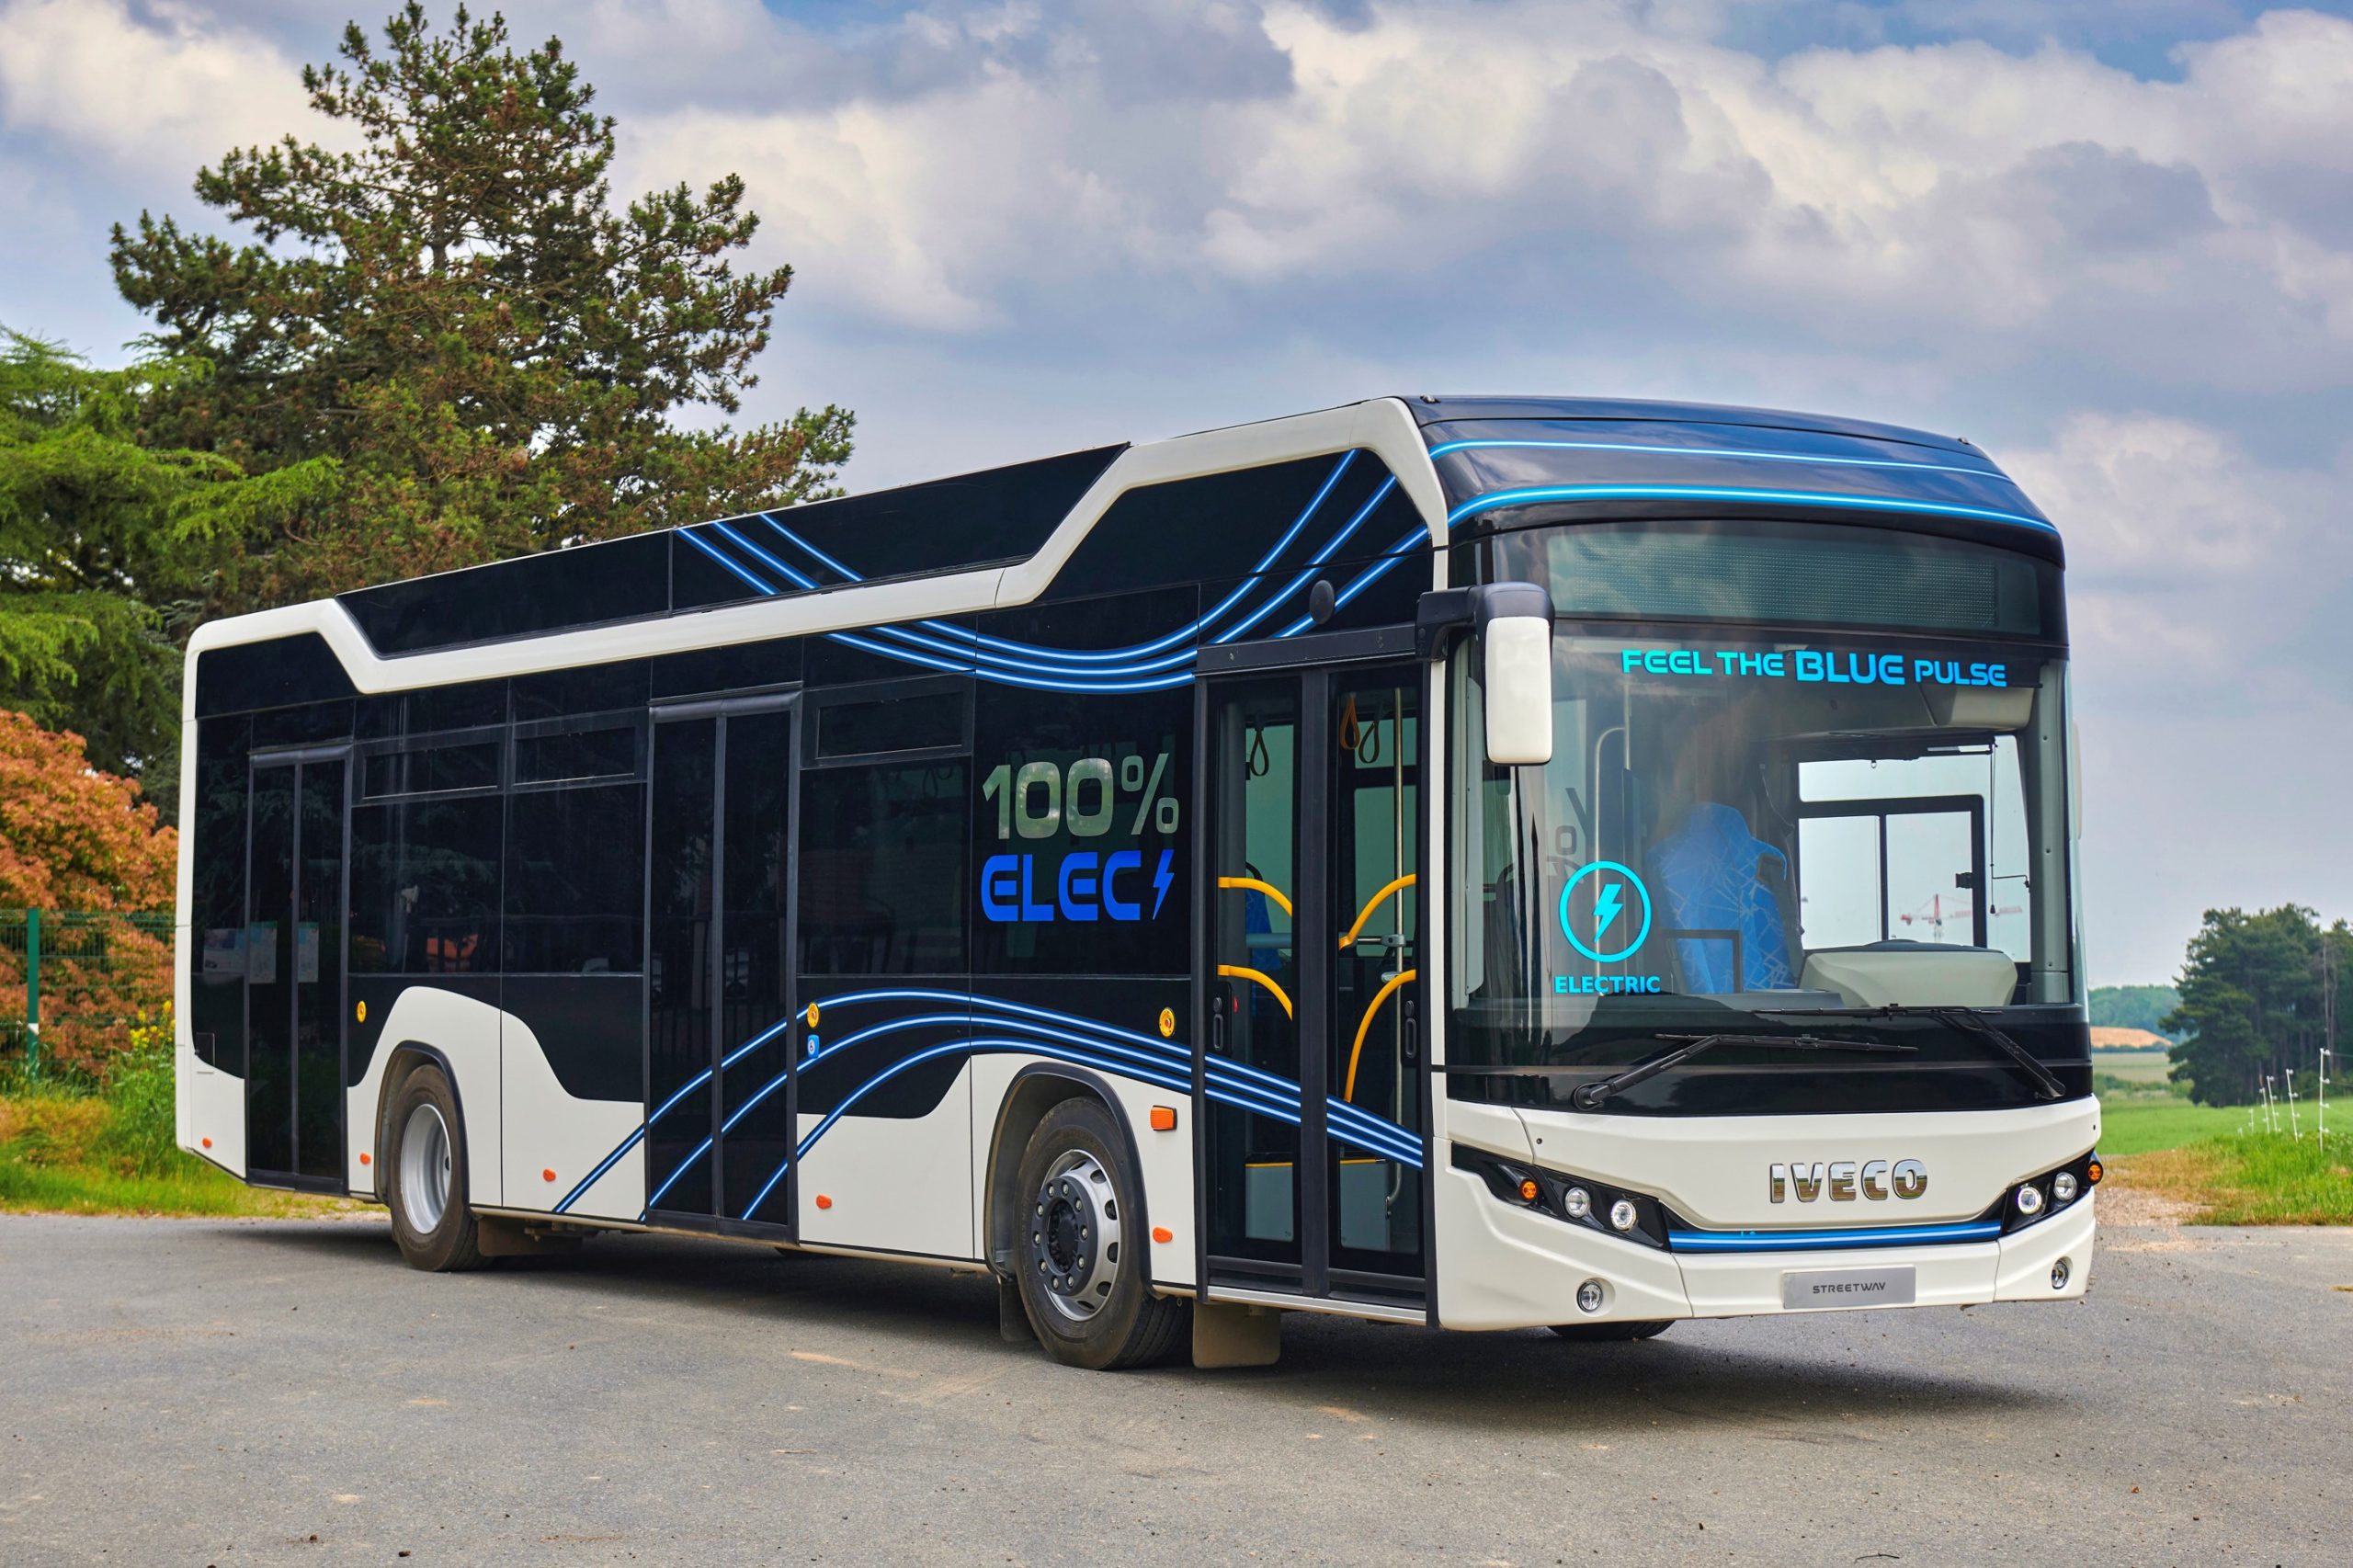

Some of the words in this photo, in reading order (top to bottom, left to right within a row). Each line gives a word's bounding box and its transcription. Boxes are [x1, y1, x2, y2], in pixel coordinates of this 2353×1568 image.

[1621, 649, 1713, 676] FEEL
[1715, 651, 1786, 677] THE
[1794, 650, 1905, 686] BLUE
[1915, 659, 2007, 687] PULSE
[982, 753, 1179, 840] 100%
[981, 849, 1142, 922] ELEC
[1553, 975, 1661, 994] ELECTRIC
[1770, 1159, 1927, 1203] IVECO
[1813, 1282, 1886, 1294] STREETWAY
